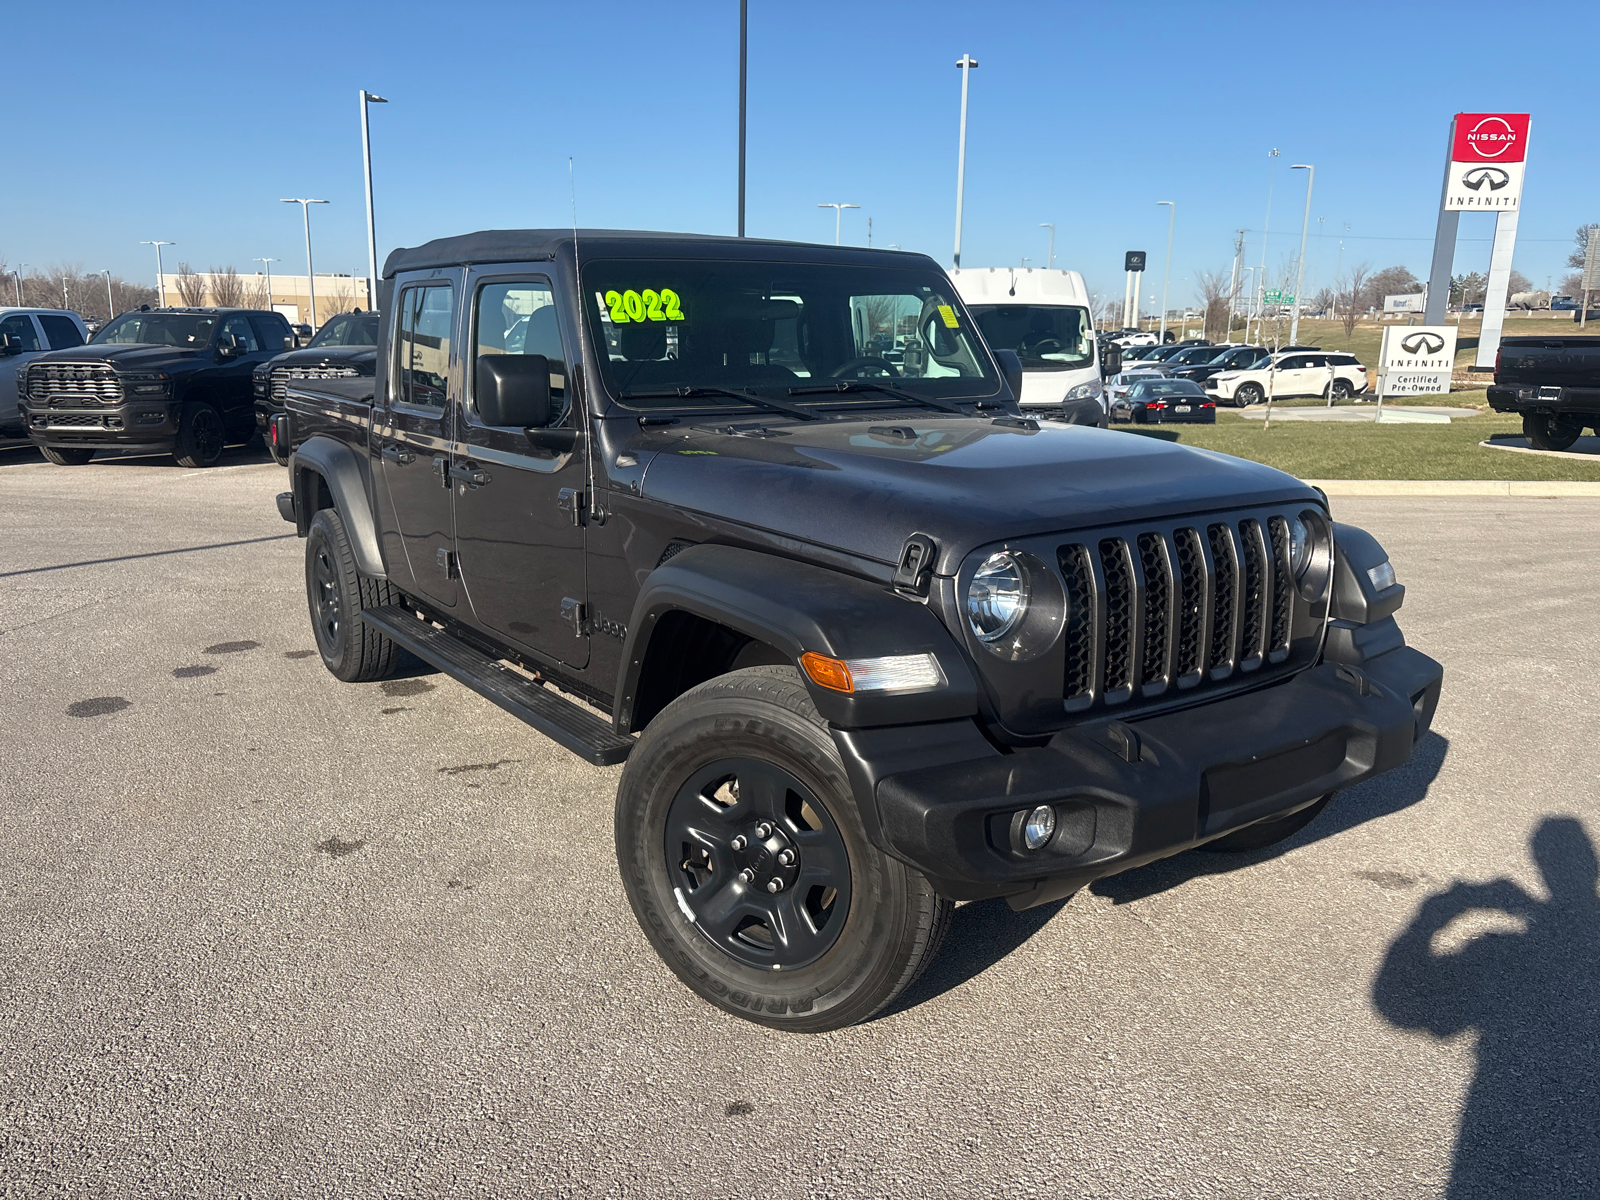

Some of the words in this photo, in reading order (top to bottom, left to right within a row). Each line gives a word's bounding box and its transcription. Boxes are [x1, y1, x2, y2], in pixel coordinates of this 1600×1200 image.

[1467, 133, 1516, 141] NISSAN
[1449, 197, 1517, 206] INFINITI
[605, 288, 685, 324] 2022
[1390, 359, 1449, 368] INFINITI
[46, 370, 94, 380] RAM
[1397, 375, 1438, 384] Certified
[1391, 384, 1442, 392] Pre-Owned
[593, 610, 629, 644] Jeep
